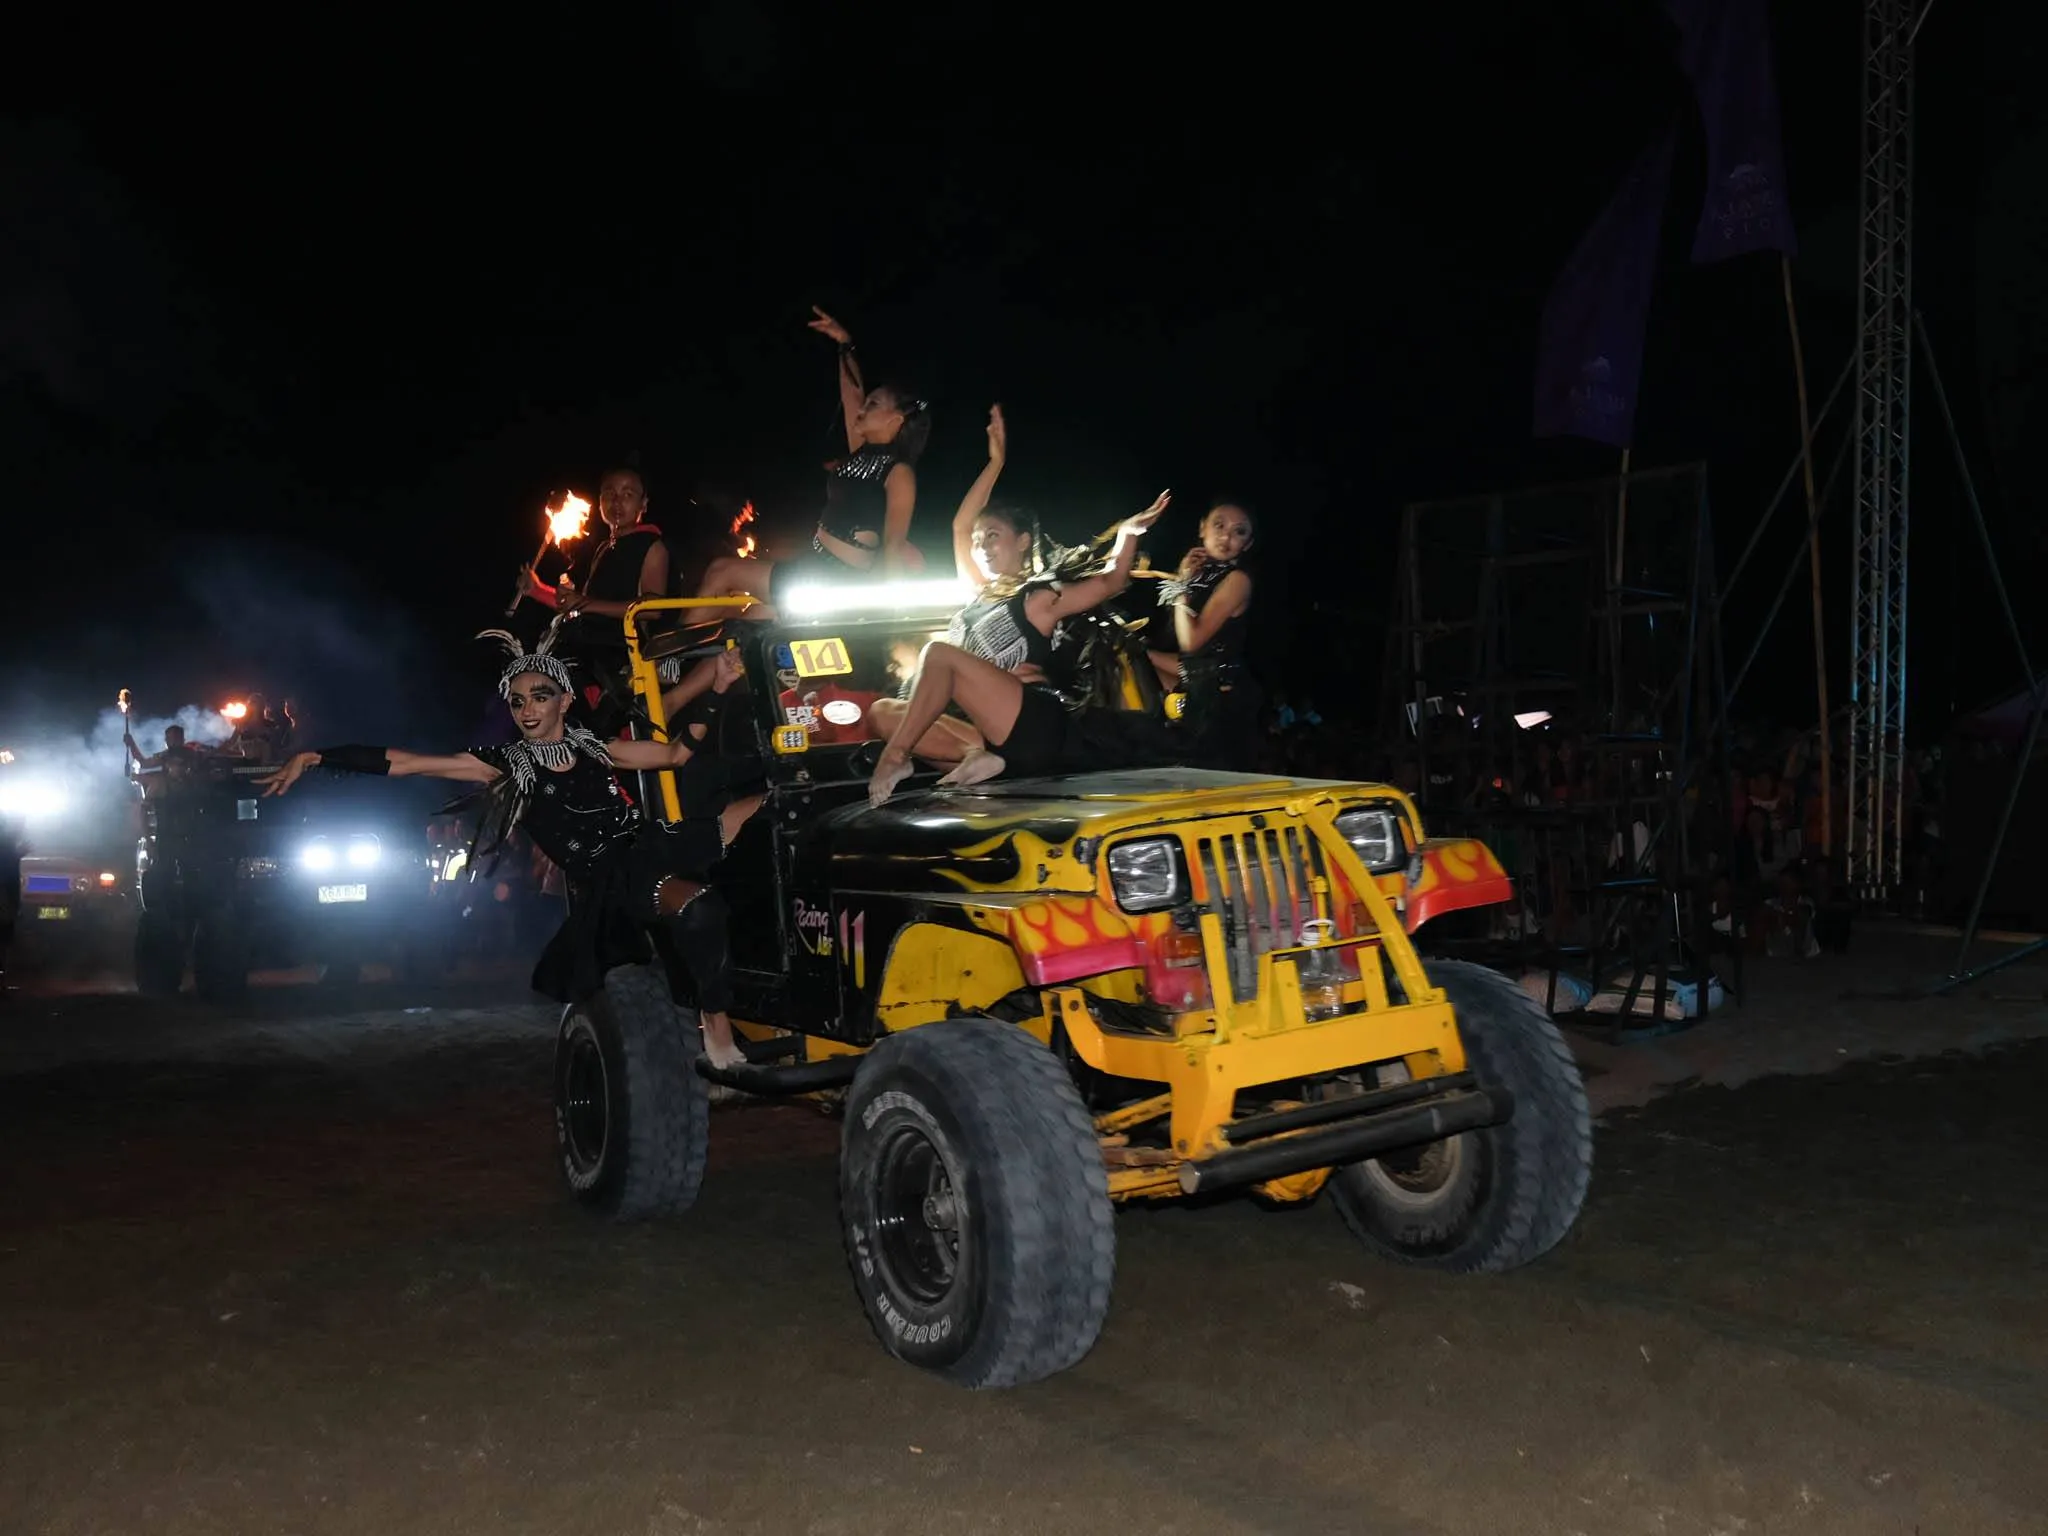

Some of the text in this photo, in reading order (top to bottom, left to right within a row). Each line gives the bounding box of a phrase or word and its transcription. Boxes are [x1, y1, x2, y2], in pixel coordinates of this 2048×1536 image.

[797, 641, 847, 674] 14
[839, 907, 865, 989] 11
[876, 1292, 951, 1344] COURSER
